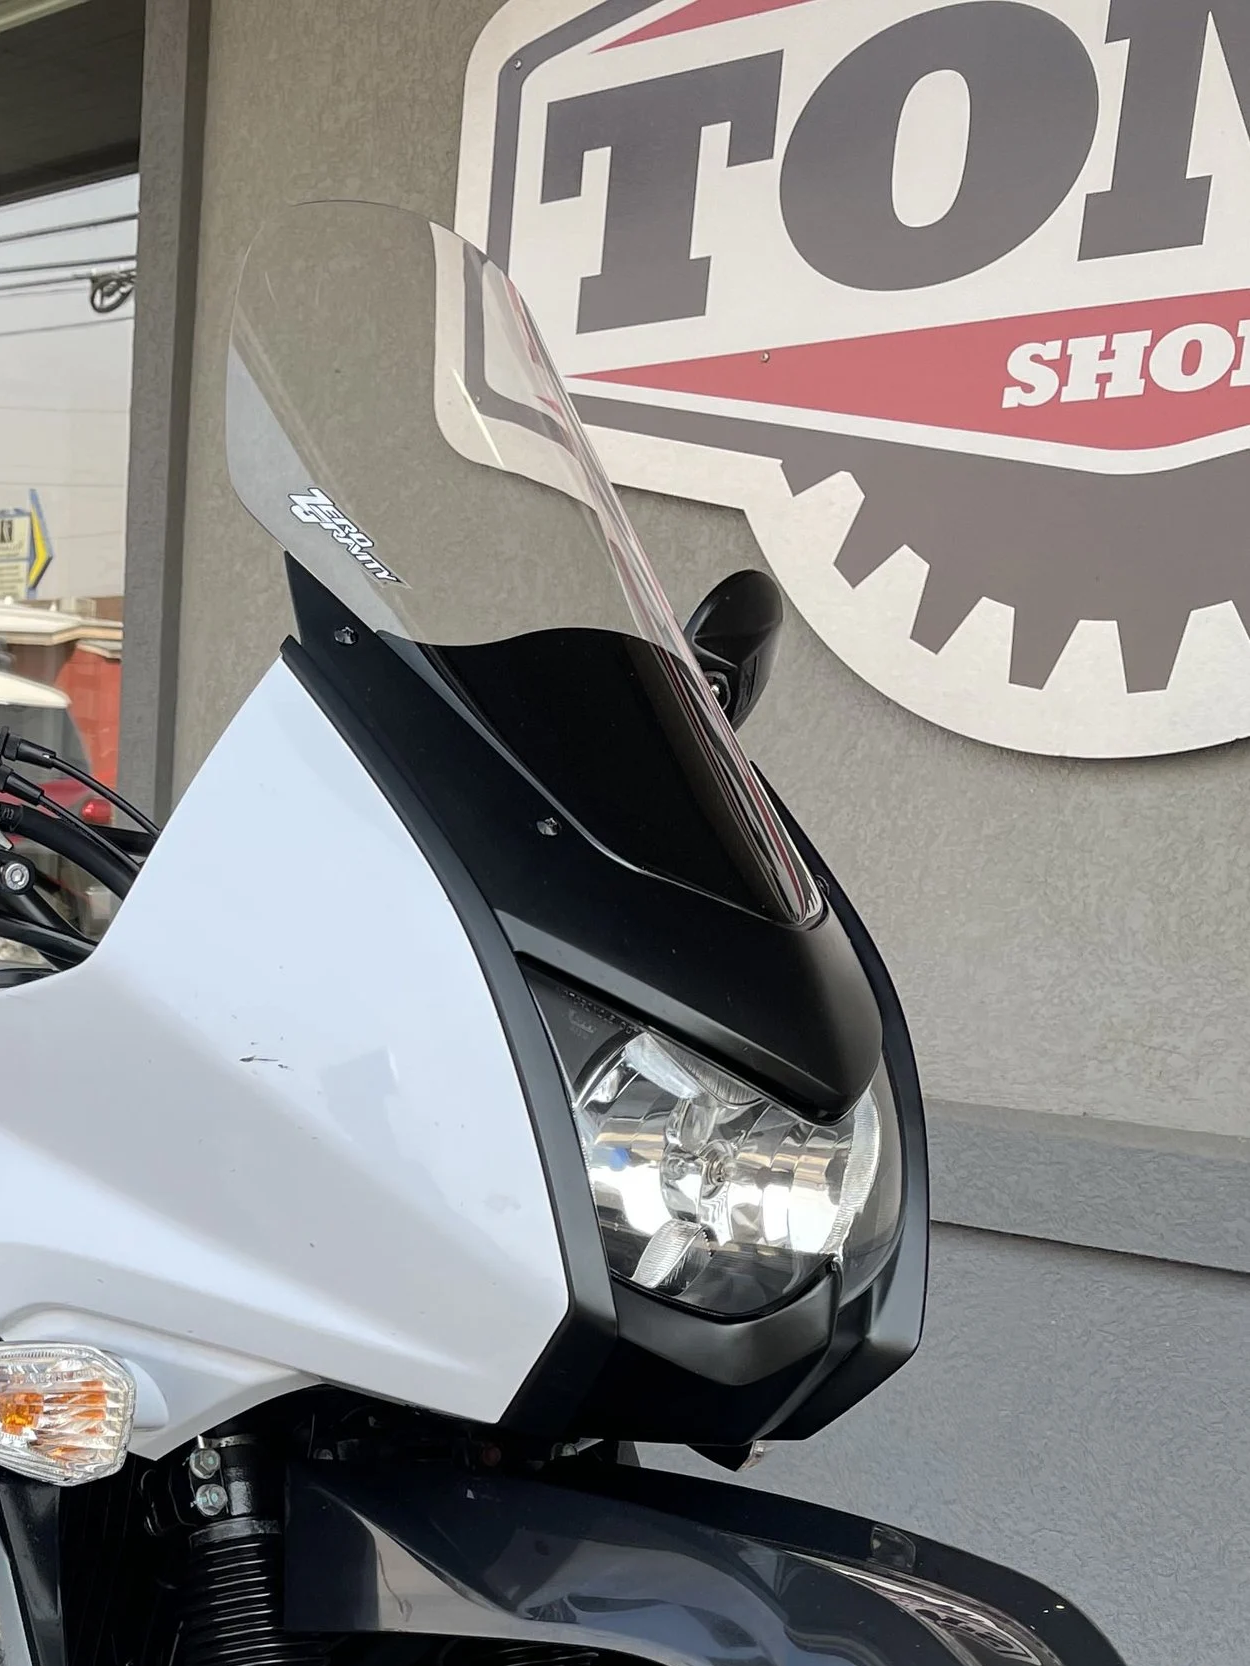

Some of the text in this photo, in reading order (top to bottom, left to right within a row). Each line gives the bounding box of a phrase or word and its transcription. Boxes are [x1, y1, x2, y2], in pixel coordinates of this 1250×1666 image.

[1002, 322, 1250, 410] SHO
[288, 487, 374, 549] ZERO
[290, 503, 403, 582] GRAVITY
